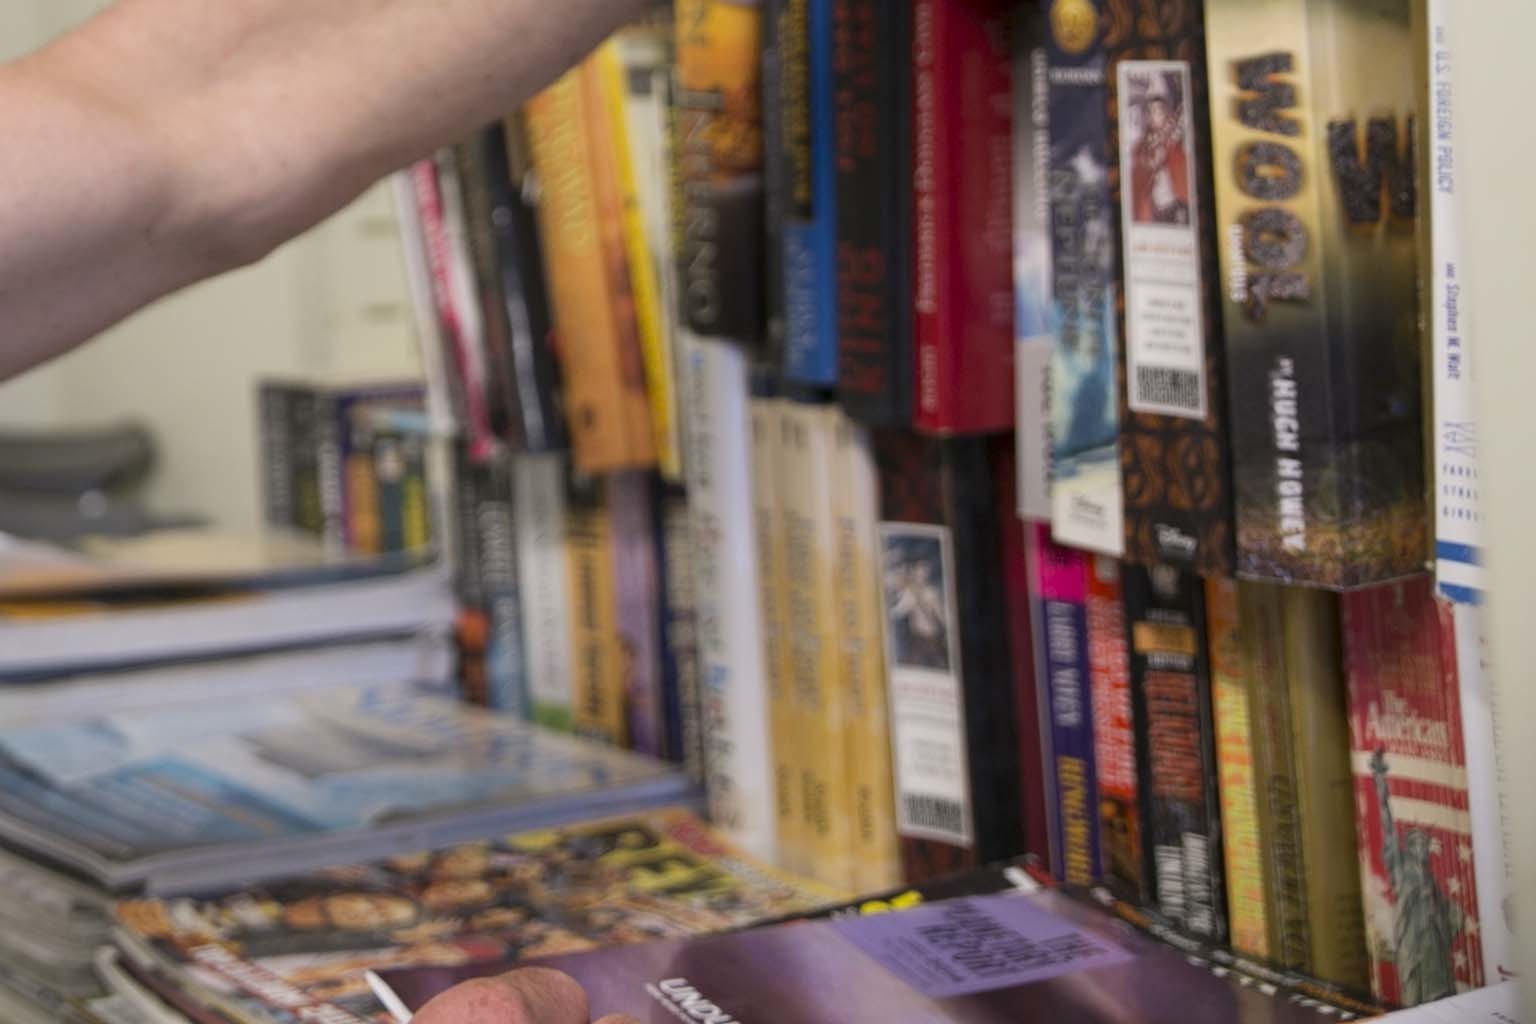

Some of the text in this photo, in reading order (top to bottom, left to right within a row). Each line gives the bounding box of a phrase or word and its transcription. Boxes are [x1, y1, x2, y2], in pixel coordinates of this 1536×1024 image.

[1435, 80, 1453, 140] FOREIGN
[676, 88, 723, 325] INFERNO
[1227, 51, 1310, 323] WOOL
[1436, 145, 1455, 195] POLICY
[1271, 377, 1300, 452] HUGH
[1277, 457, 1307, 553] HOWEY
